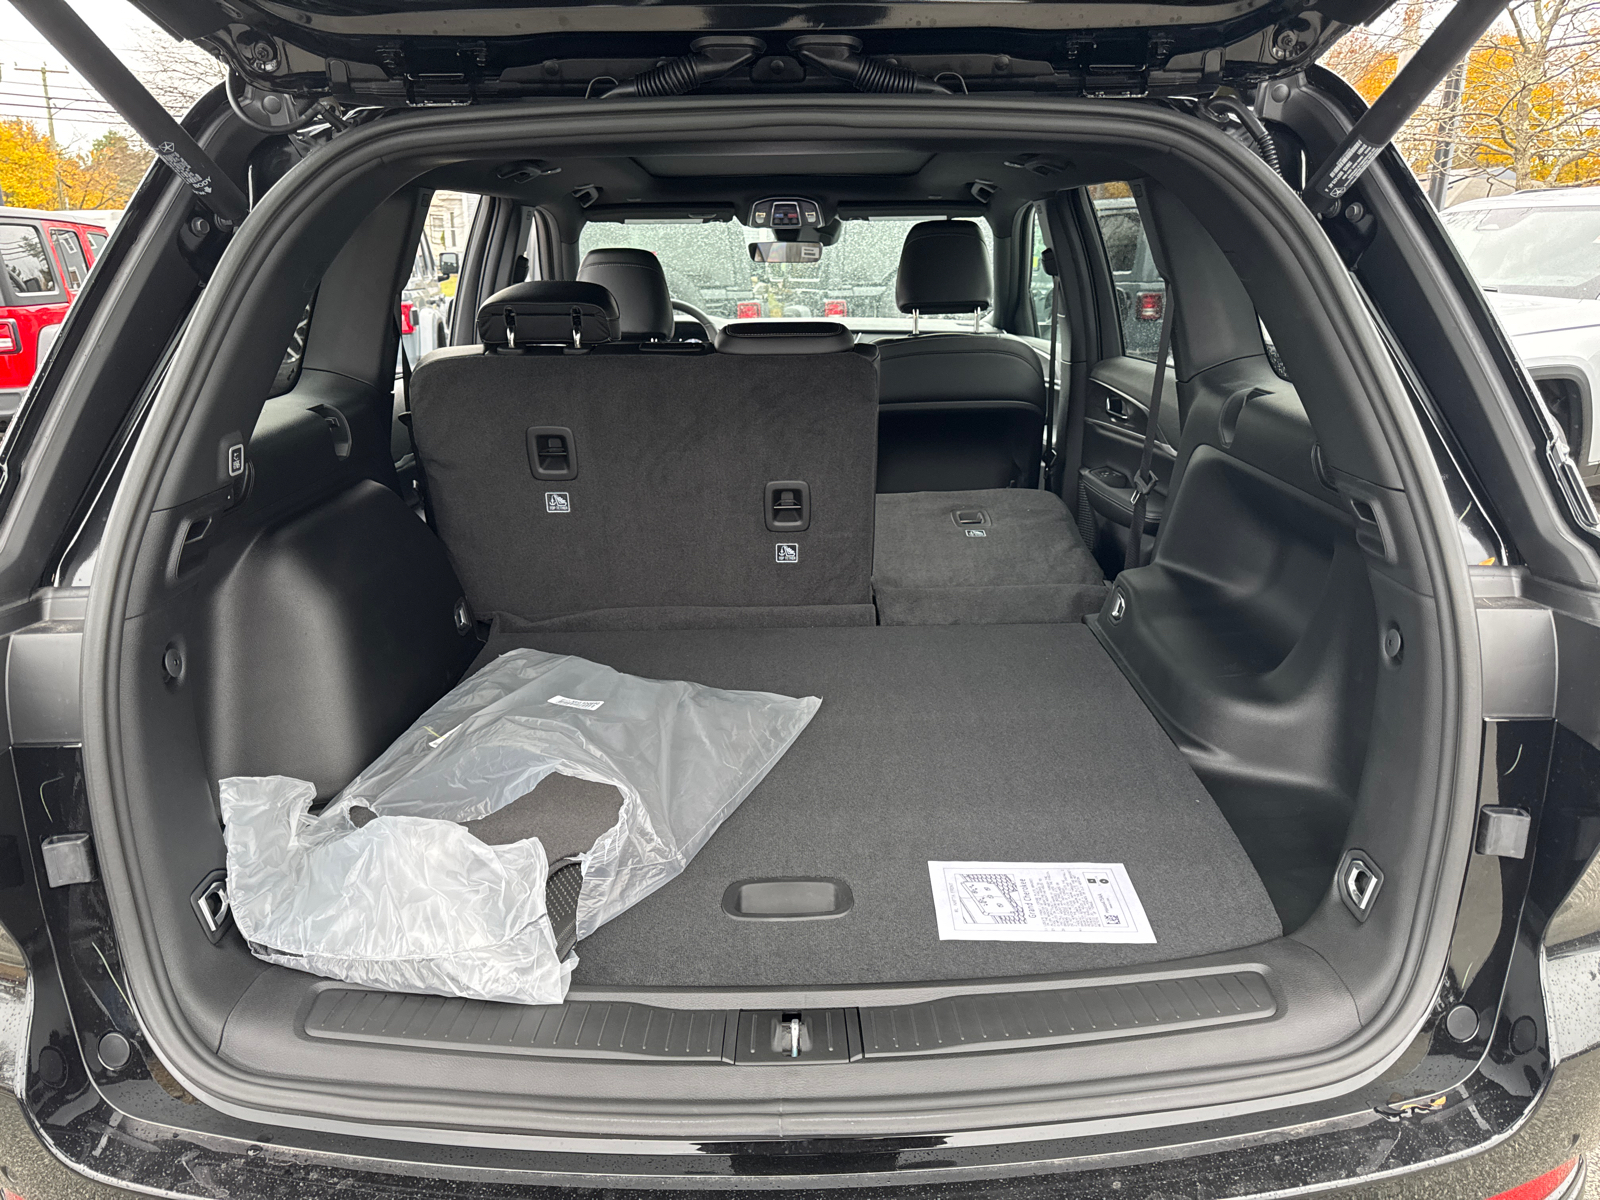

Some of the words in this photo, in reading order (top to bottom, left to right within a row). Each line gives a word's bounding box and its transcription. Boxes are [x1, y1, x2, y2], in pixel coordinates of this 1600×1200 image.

[193, 175, 212, 188] BODY
[1018, 878, 1032, 902] Cherokee
[1026, 902, 1037, 919] Grand
